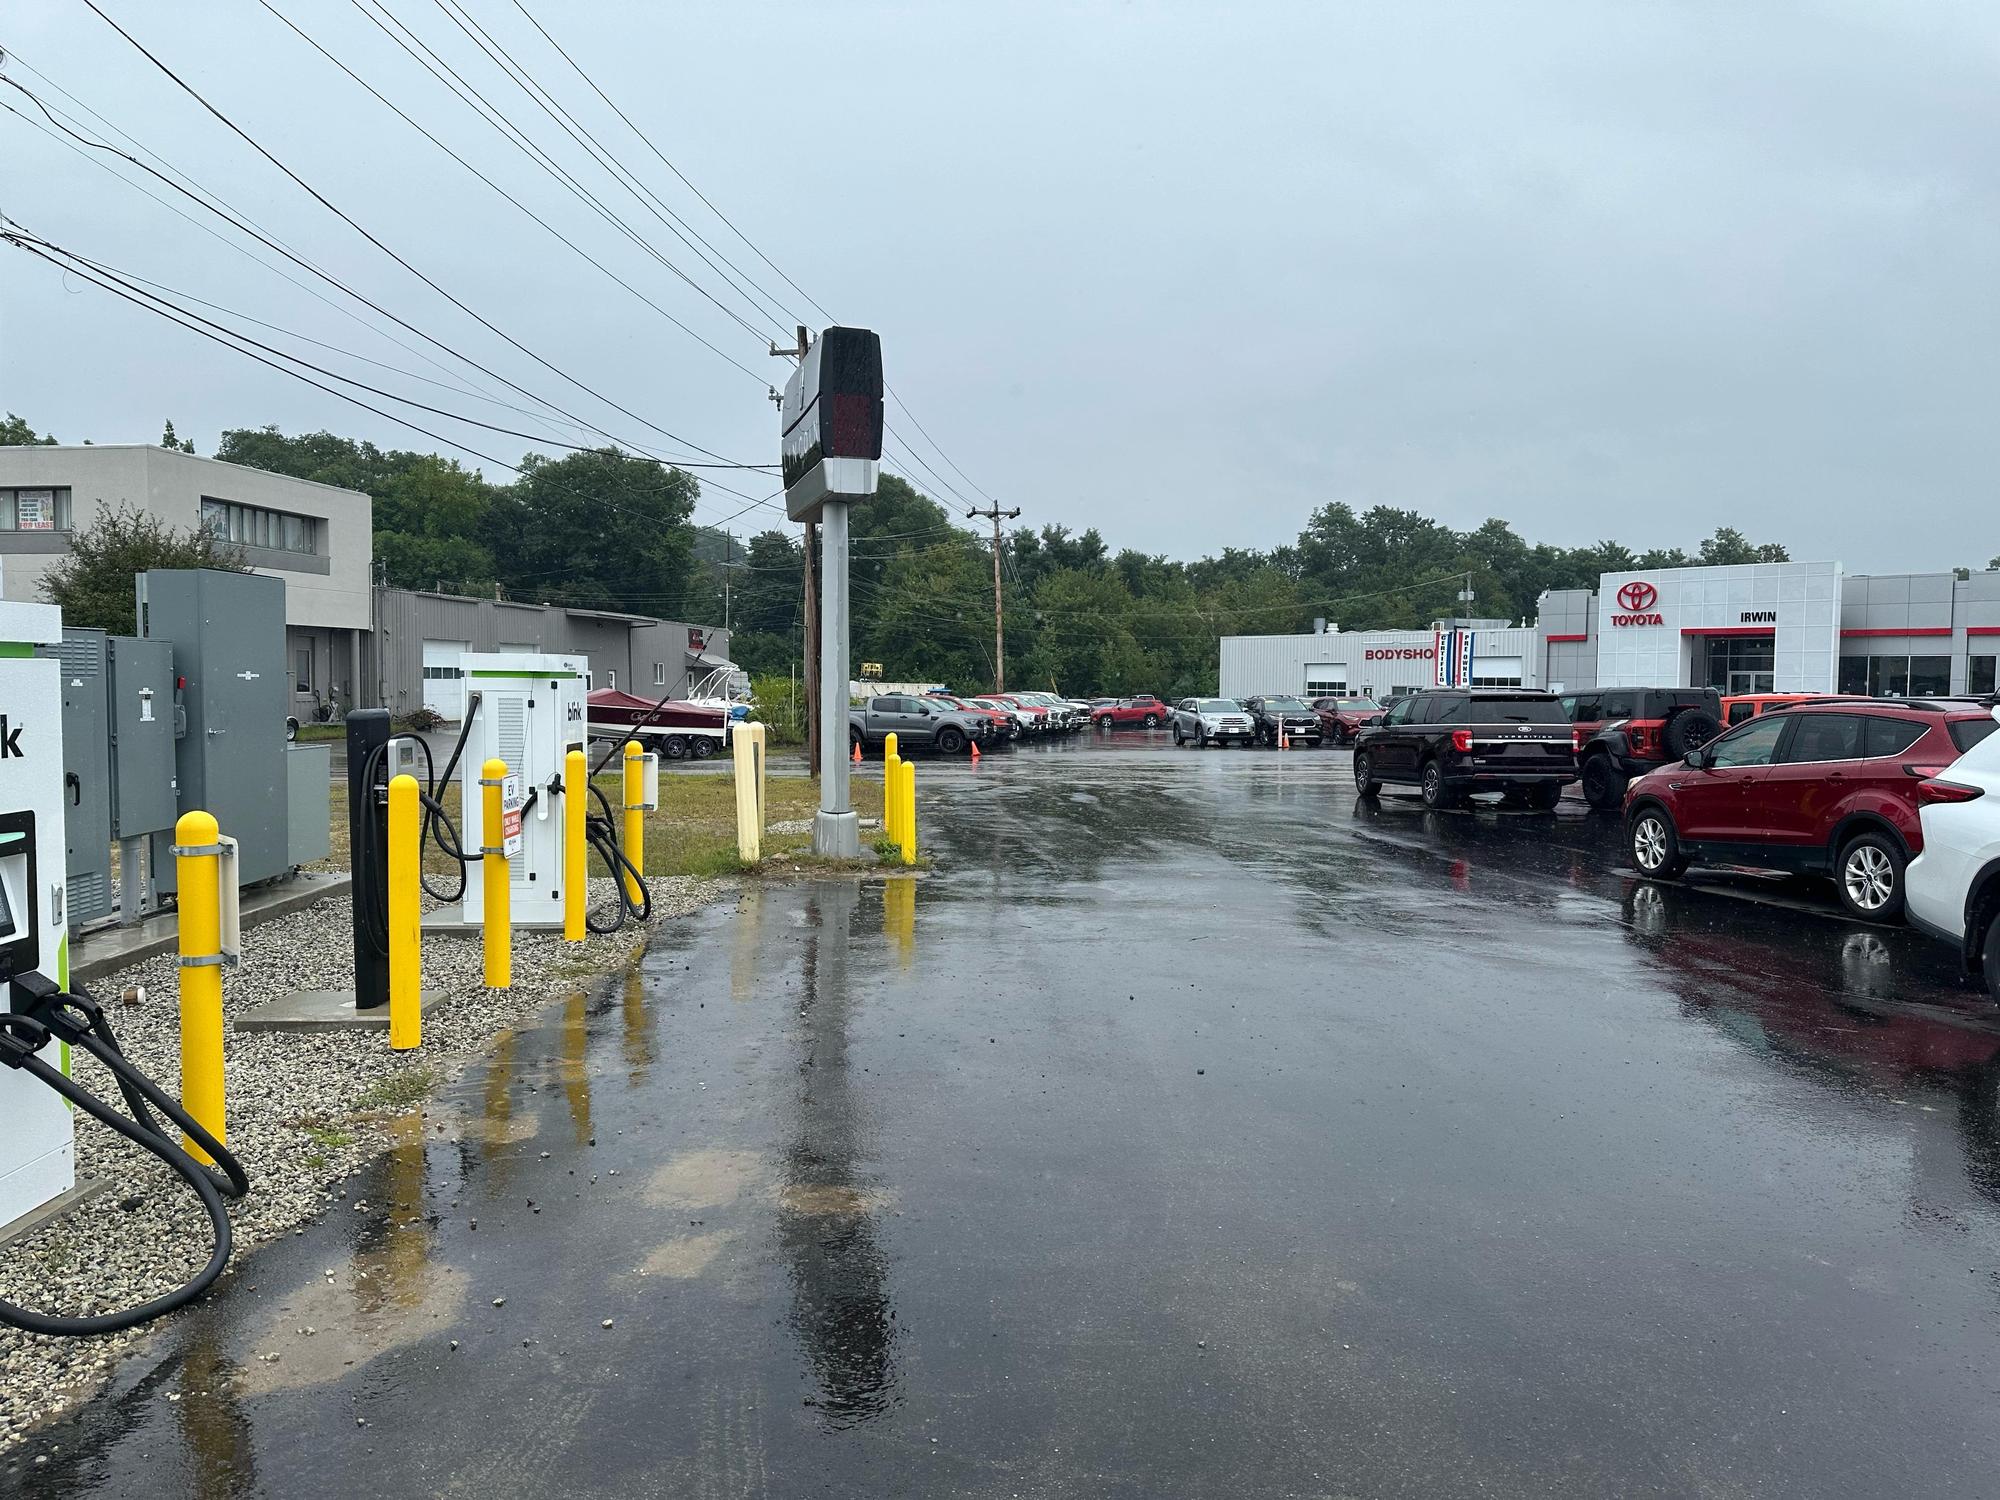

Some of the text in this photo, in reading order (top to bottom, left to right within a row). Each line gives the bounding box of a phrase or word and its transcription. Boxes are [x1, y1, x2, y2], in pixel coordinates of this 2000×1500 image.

[1610, 613, 1664, 626] TOYOTA
[1740, 611, 1777, 623] IRWIN
[1365, 648, 1434, 660] BODYSHO
[1439, 635, 1447, 683] CERTIFIED
[567, 701, 582, 721] blink
[508, 784, 515, 796] EV
[504, 796, 519, 810] PARKING
